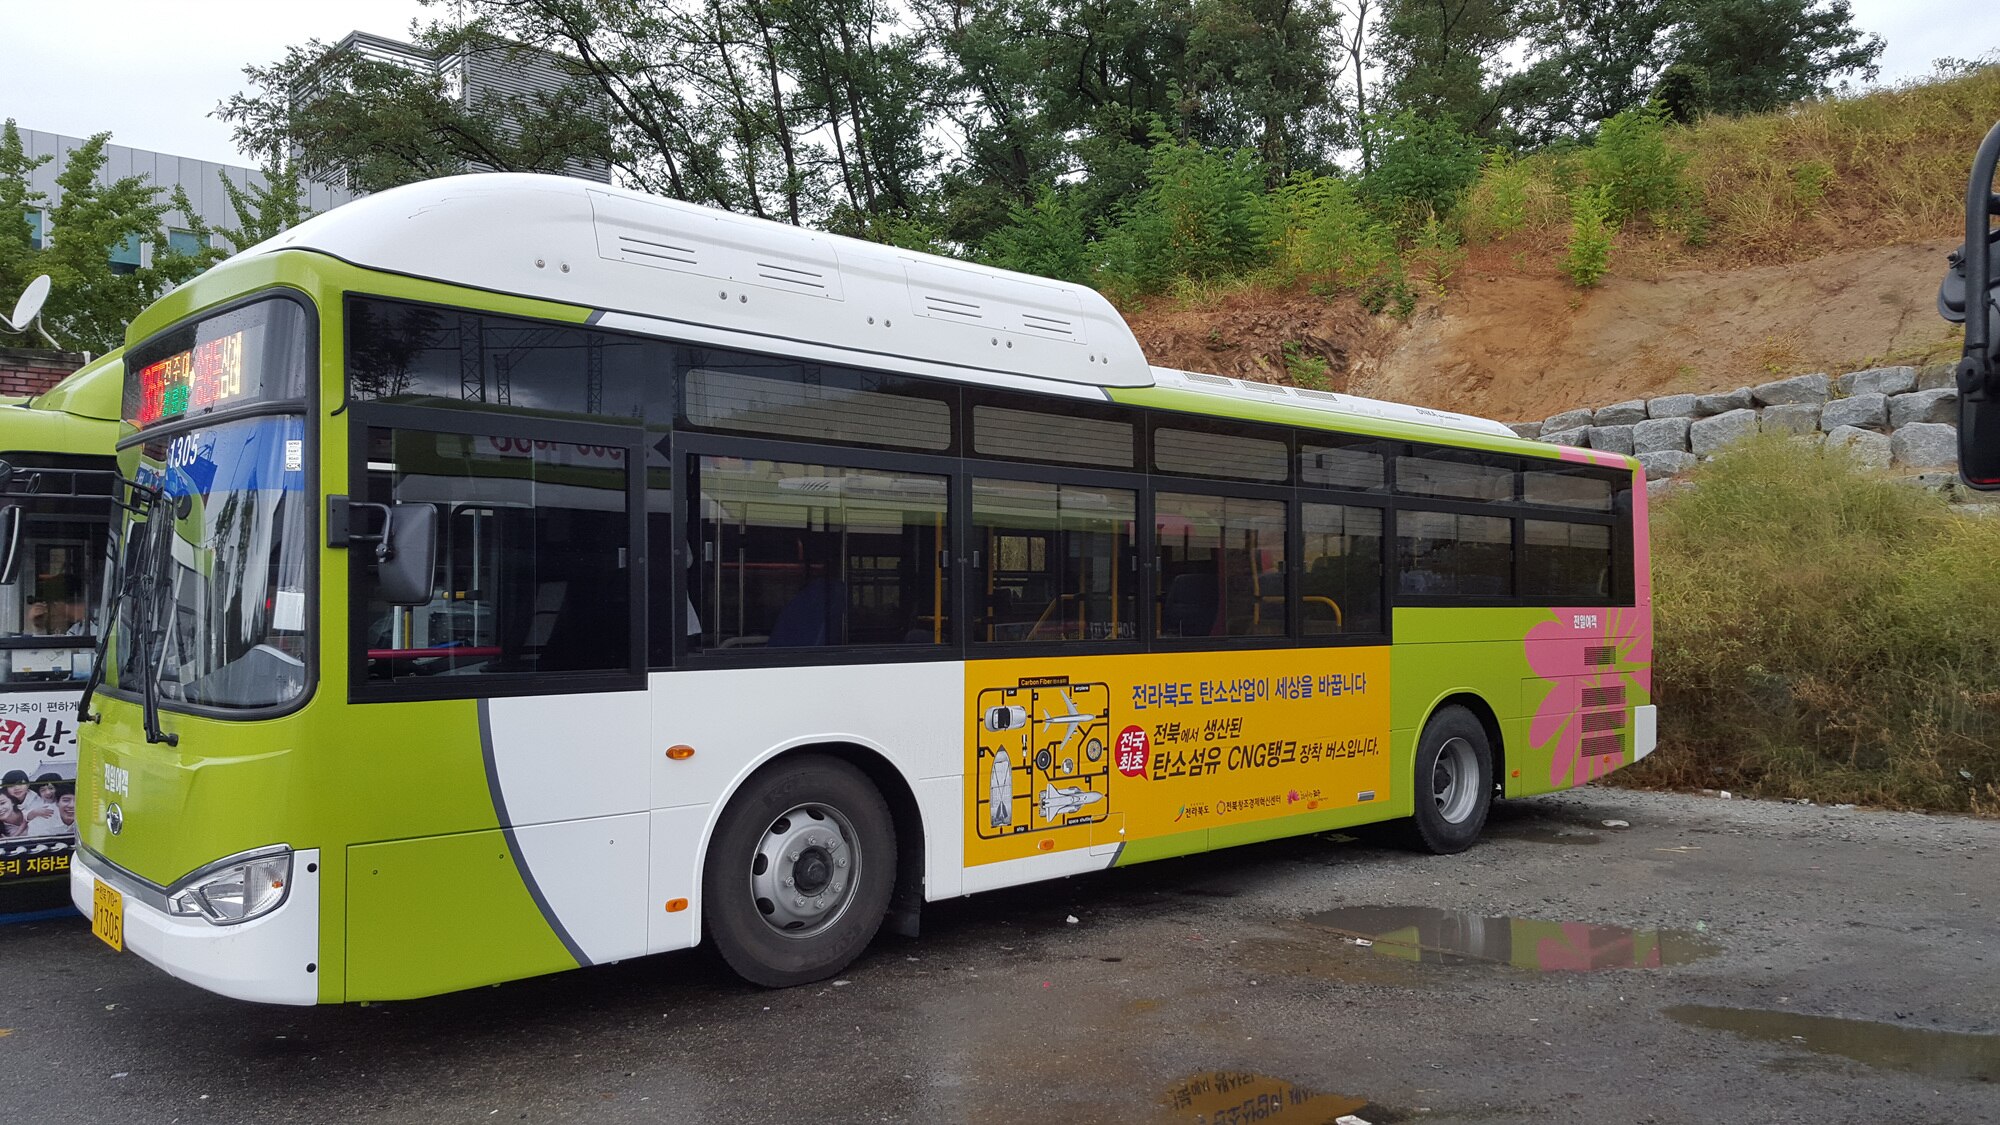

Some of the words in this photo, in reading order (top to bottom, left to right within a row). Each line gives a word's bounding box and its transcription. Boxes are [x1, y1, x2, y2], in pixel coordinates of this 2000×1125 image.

[169, 433, 200, 469] 1305
[1573, 614, 1597, 629] 전일여객
[1020, 678, 1040, 686] Carbon
[1132, 683, 1194, 710] 전라북도
[1200, 677, 1269, 705] 탄소산업이
[1274, 675, 1313, 700] 세상을
[1318, 672, 1367, 697] 바꿉니다
[1120, 731, 1146, 752] 전국
[1153, 722, 1200, 746] 전북에서
[1203, 717, 1243, 742] 생산된
[1118, 751, 1144, 772] 최초
[1152, 746, 1222, 781] 탄소섬유
[1227, 740, 1297, 771] CNG탱크
[1299, 742, 1323, 764] 장착
[1325, 736, 1379, 760] 버스입니다.
[104, 762, 129, 798] 전일여객
[1185, 804, 1210, 819] 전라북도
[100, 905, 120, 944] 1305
